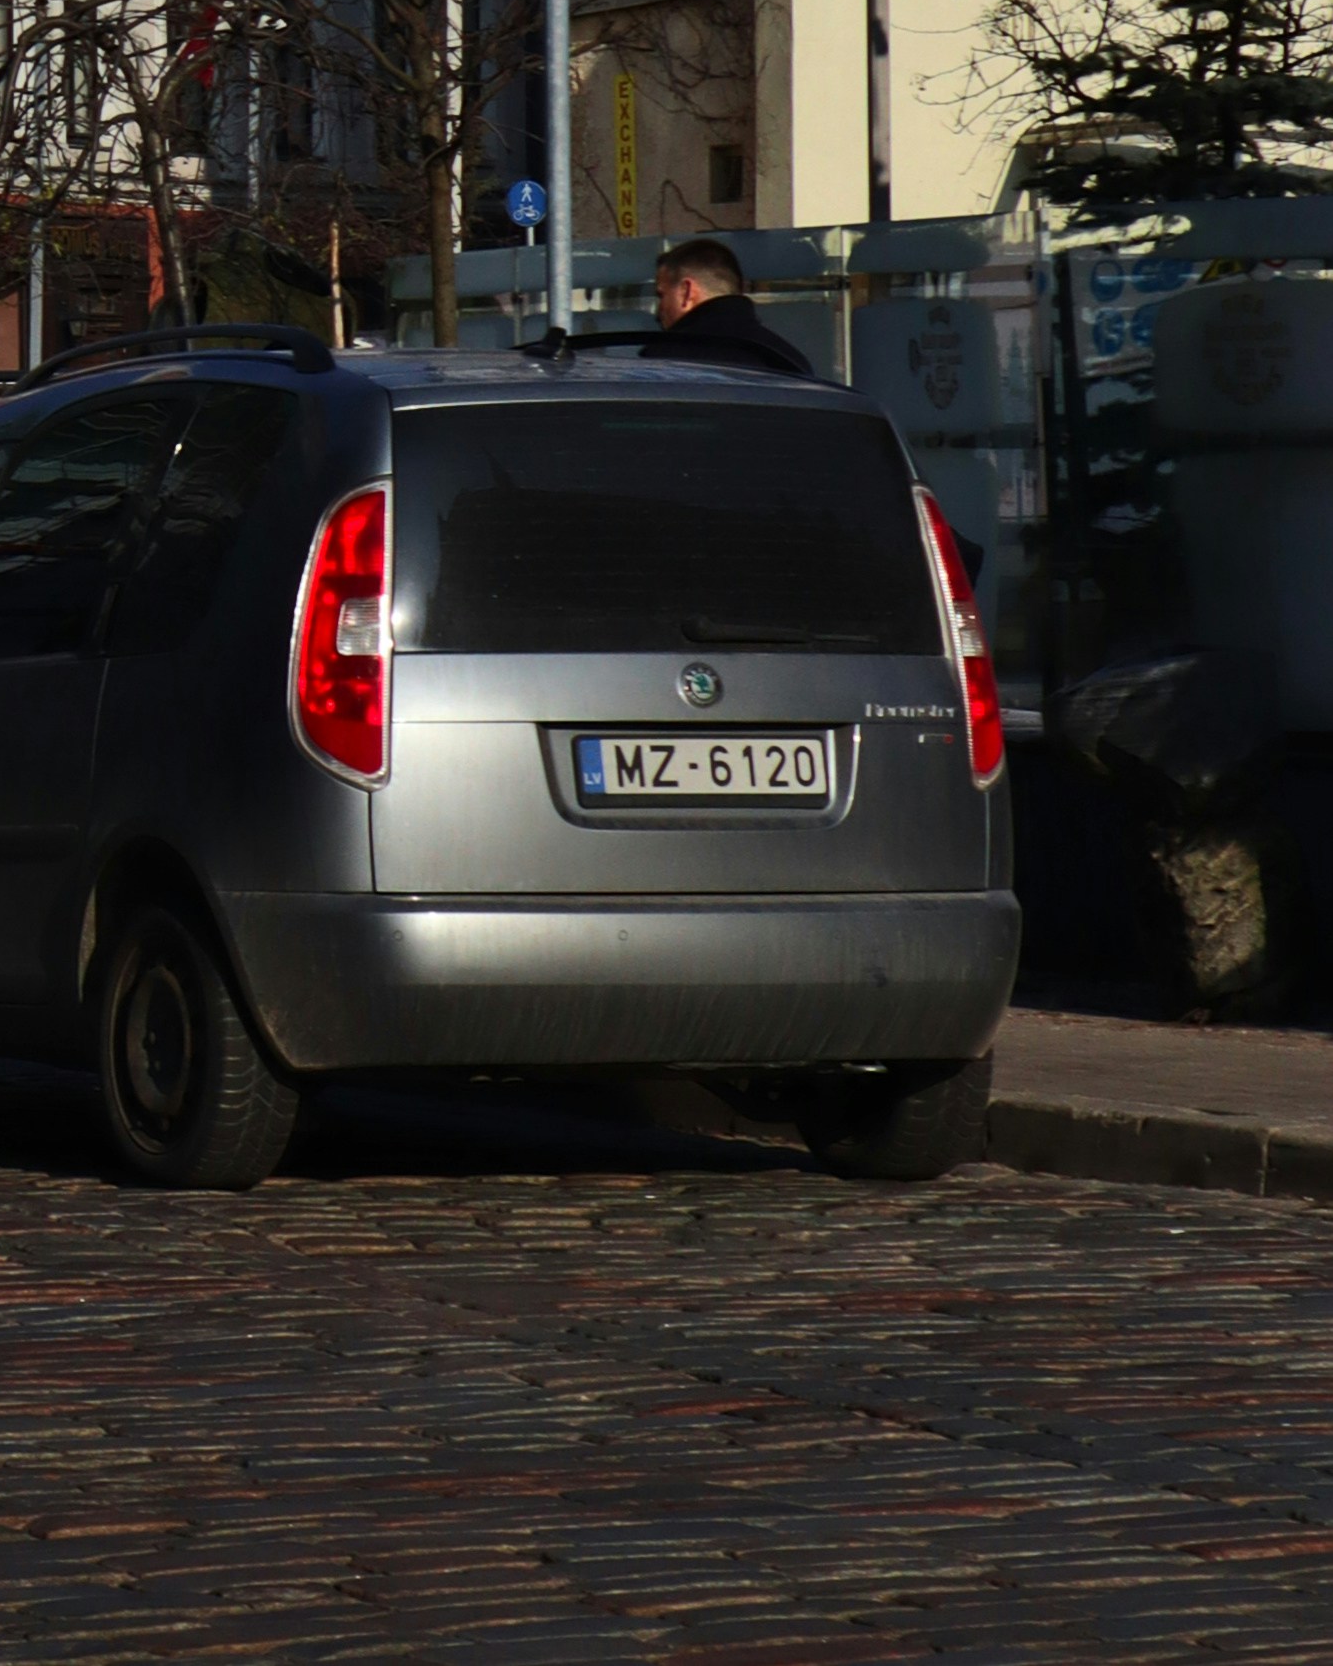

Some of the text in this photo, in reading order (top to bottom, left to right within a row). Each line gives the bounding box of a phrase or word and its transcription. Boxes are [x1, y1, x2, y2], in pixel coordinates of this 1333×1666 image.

[618, 81, 634, 239] EXCHANG
[584, 744, 816, 788] LV MZ-6120
